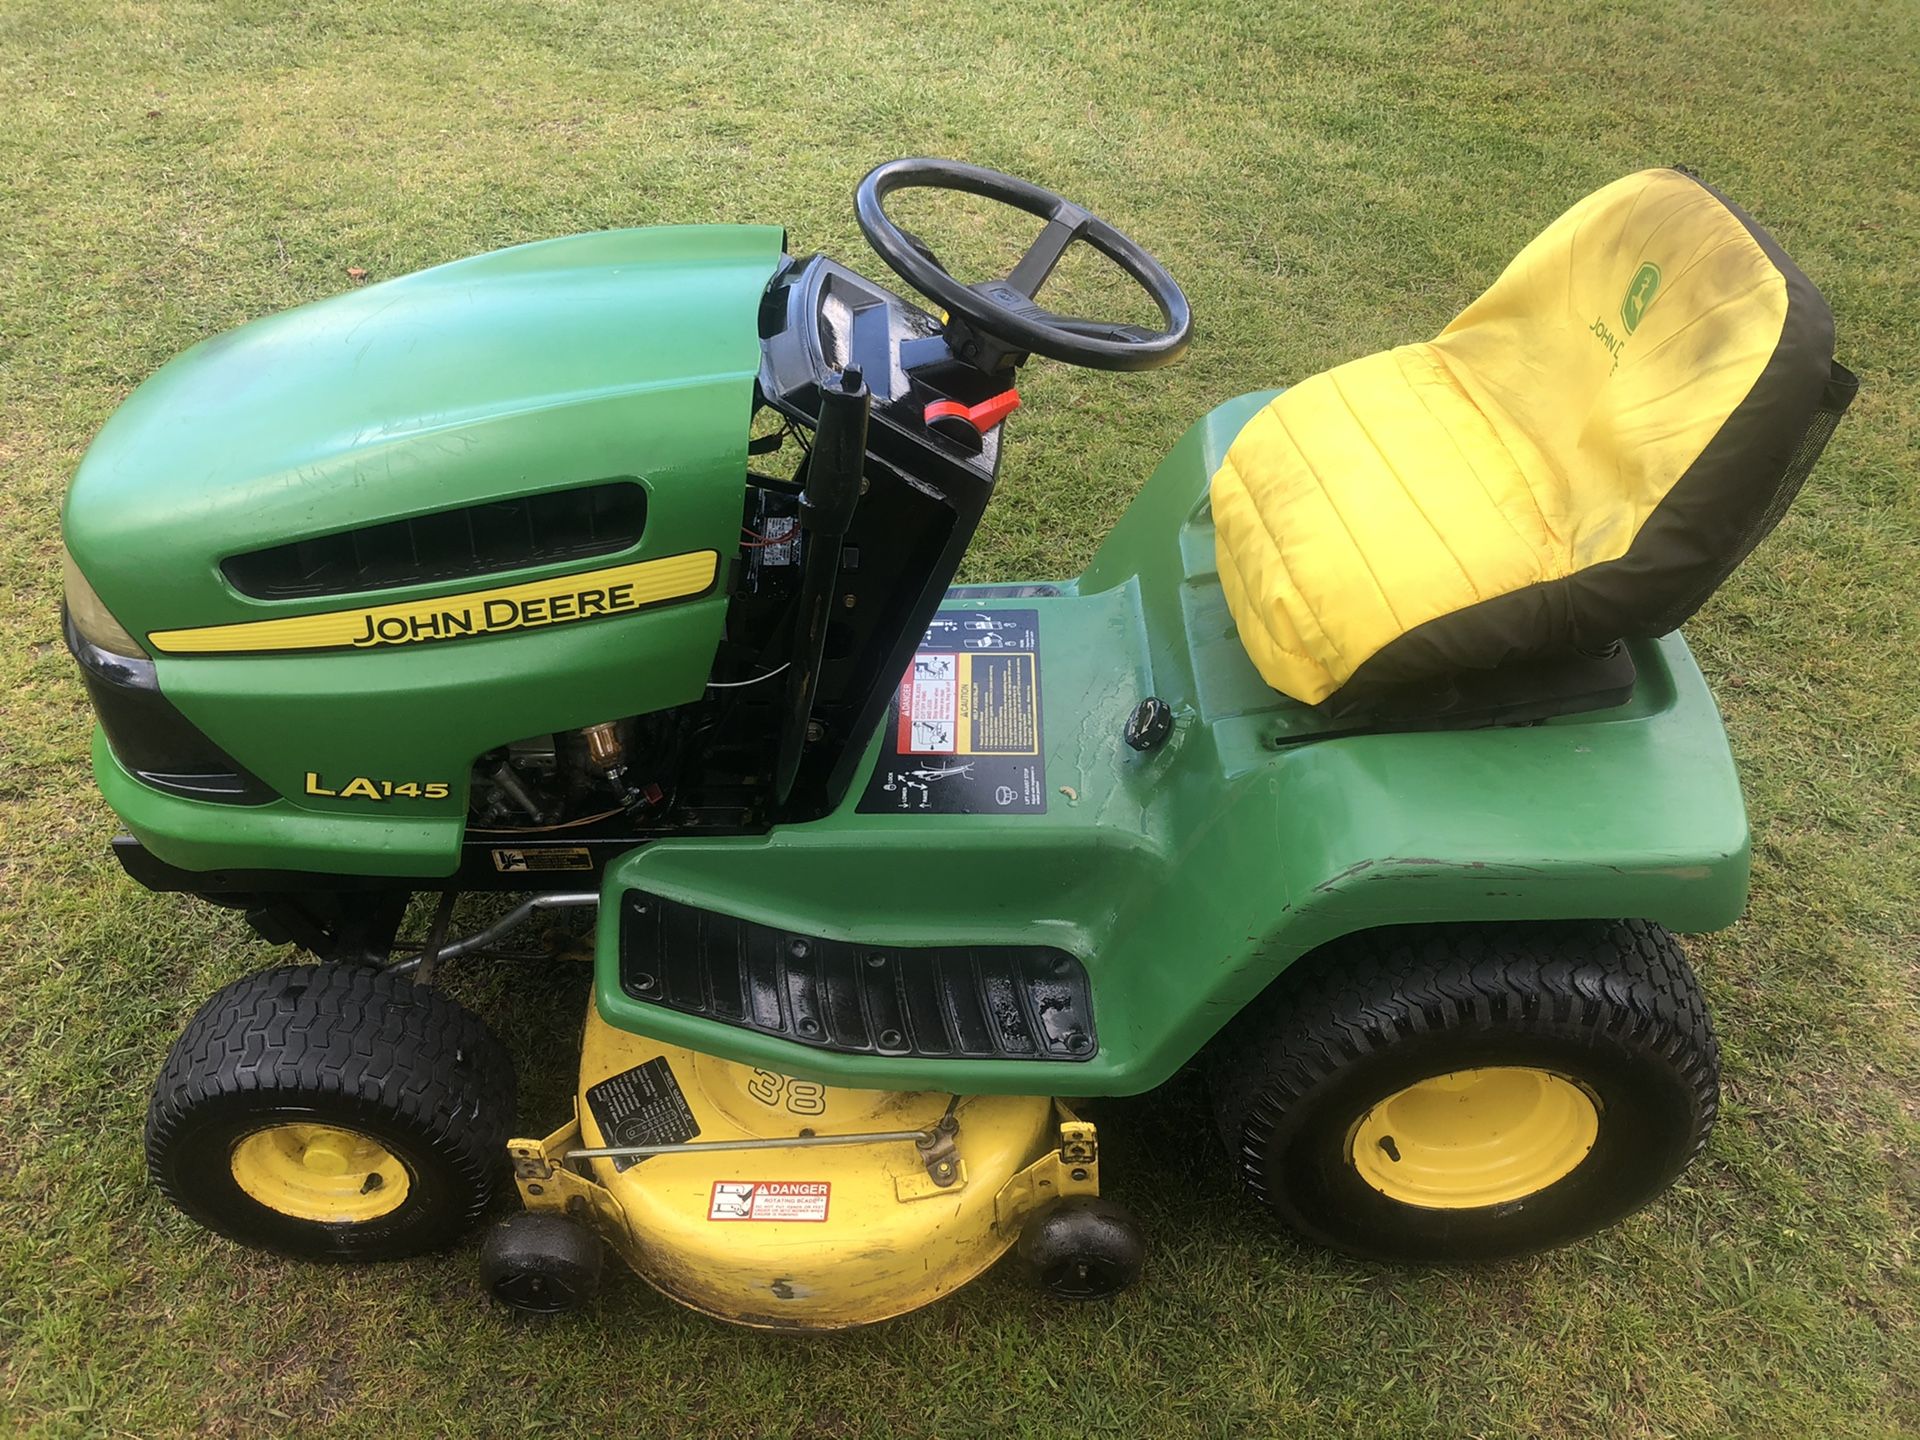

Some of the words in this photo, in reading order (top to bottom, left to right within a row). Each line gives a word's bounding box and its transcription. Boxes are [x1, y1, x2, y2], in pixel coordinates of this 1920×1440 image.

[1589, 315, 1618, 353] JOHN
[353, 609, 472, 644] JOHN
[483, 584, 635, 628] DEERE
[902, 684, 911, 710] DANGER
[306, 772, 450, 800] LA145
[748, 1067, 826, 1116] 38
[770, 1184, 828, 1194] DANGER
